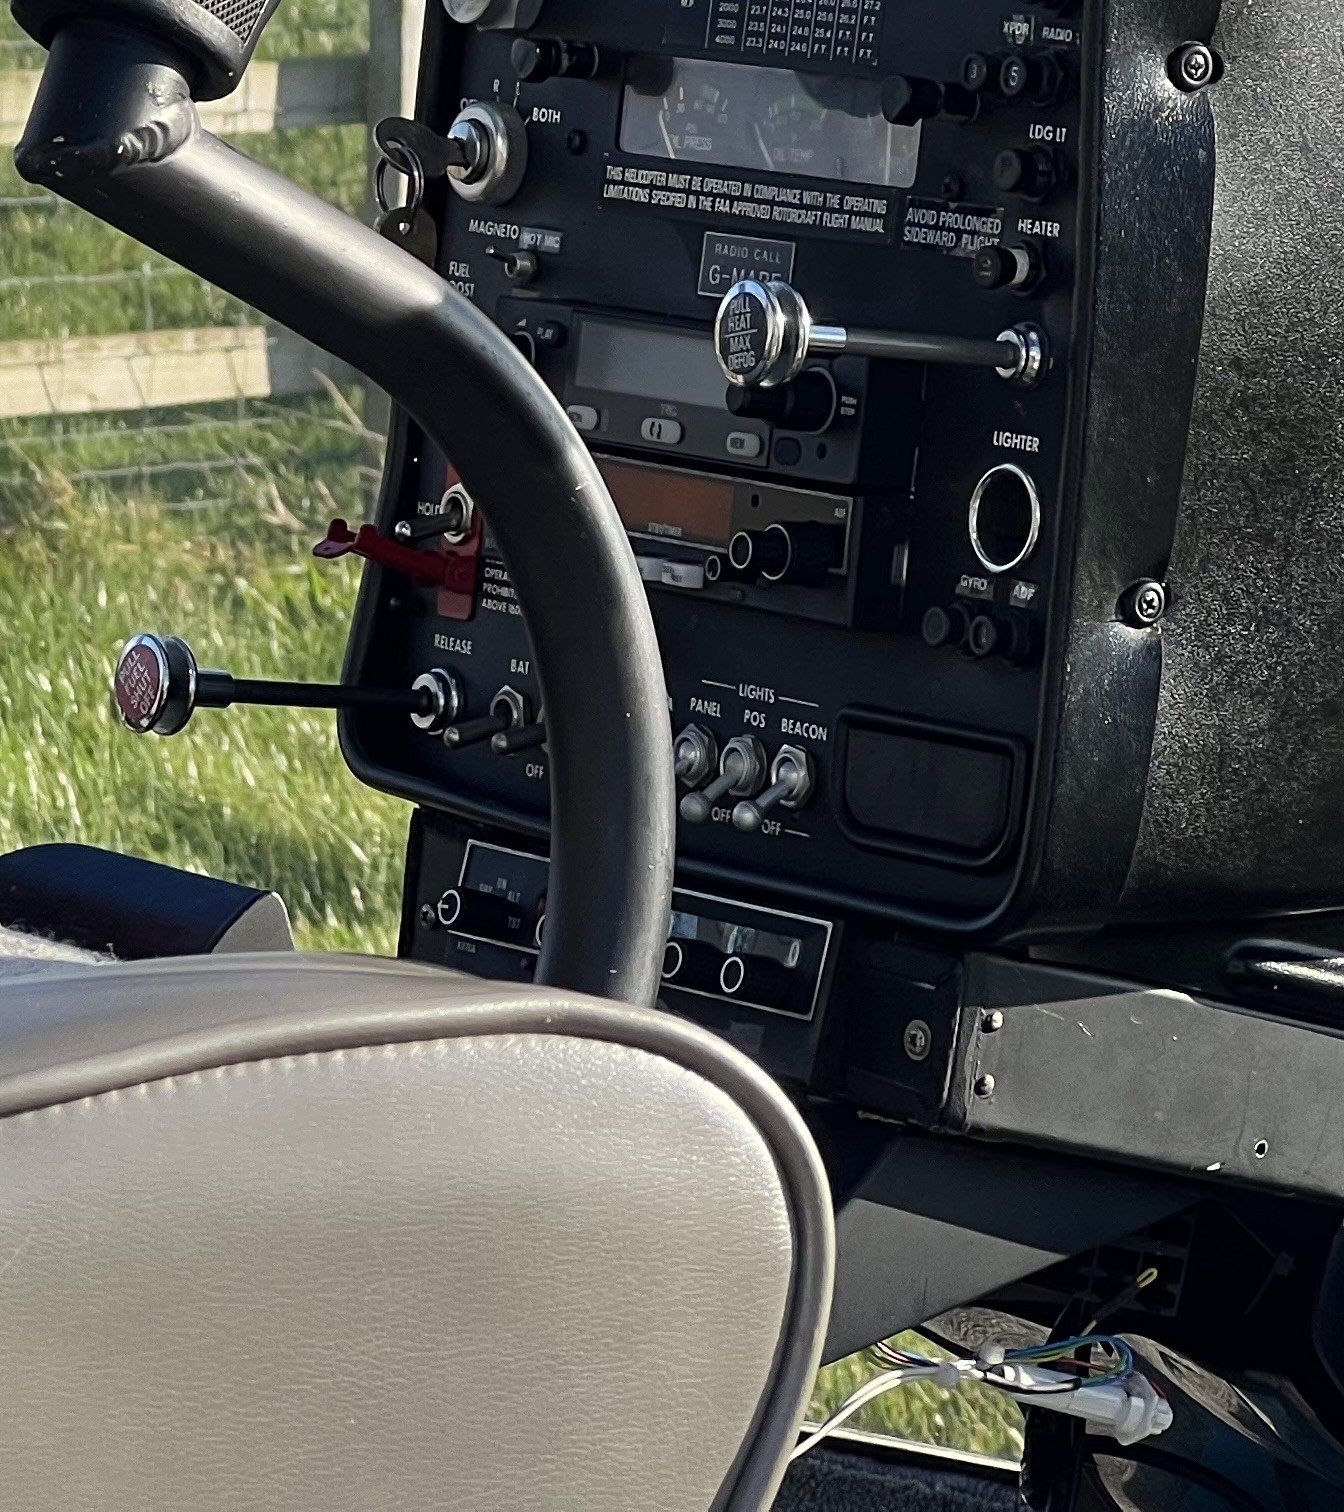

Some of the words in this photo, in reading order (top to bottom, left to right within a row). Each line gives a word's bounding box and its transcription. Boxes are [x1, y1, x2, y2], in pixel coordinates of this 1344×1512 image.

[1002, 21, 1030, 35] XPDR
[1042, 26, 1073, 42] RADIO
[493, 79, 500, 92] R
[1009, 67, 1018, 86] 5
[532, 107, 561, 123] BOTH
[1029, 124, 1053, 141] LDG
[1056, 127, 1067, 142] LT
[606, 165, 623, 180] THIS
[624, 168, 666, 186] HELICOPTER
[667, 173, 691, 189] MUST
[691, 176, 702, 191] BE
[703, 178, 742, 196] OPERATED
[743, 183, 752, 197] IN
[753, 184, 802, 204] COMPLIANCE
[803, 190, 824, 207] WITH
[825, 193, 841, 208] THE
[843, 196, 887, 214] OPERATING
[603, 184, 650, 203] LIMITATIONS
[651, 190, 686, 208] SPECIFIED
[687, 195, 697, 209] IN
[698, 195, 713, 211] THE
[714, 198, 730, 214] FAA
[731, 200, 771, 219] APPROVED
[772, 206, 822, 225] ROTORCRAFT
[823, 212, 849, 228] FLIGHT
[850, 215, 885, 233] MANUAL
[468, 219, 519, 239] MAGNETO
[906, 207, 937, 225] AVOID
[939, 211, 1002, 234] PROLONGED
[1017, 219, 1060, 238] HEATER
[523, 232, 542, 245] HOT
[904, 226, 956, 247] SIDEWARD
[714, 243, 749, 259] RADIO
[753, 249, 781, 264] CALL
[449, 261, 470, 278] FUEL
[728, 314, 751, 333] HEAT
[730, 334, 751, 352] MAX
[728, 351, 755, 370] DEFOG
[993, 430, 1040, 452] LIGHTER
[960, 574, 988, 590] GYRO
[1013, 581, 1036, 601] ADF
[482, 598, 506, 613] ABOVE
[434, 634, 472, 655] RELEASE
[119, 651, 140, 683] PULL
[510, 659, 530, 675] BAT
[125, 662, 145, 695] FUEL
[131, 669, 151, 709] SHUT
[738, 683, 775, 704] LIGHTS
[139, 685, 155, 714] OFF
[690, 697, 721, 718] PANEL
[743, 709, 766, 728] POS
[781, 717, 827, 741] BEACON
[525, 763, 544, 779] OFF
[711, 807, 731, 823] OFF
[761, 819, 782, 836] OFF
